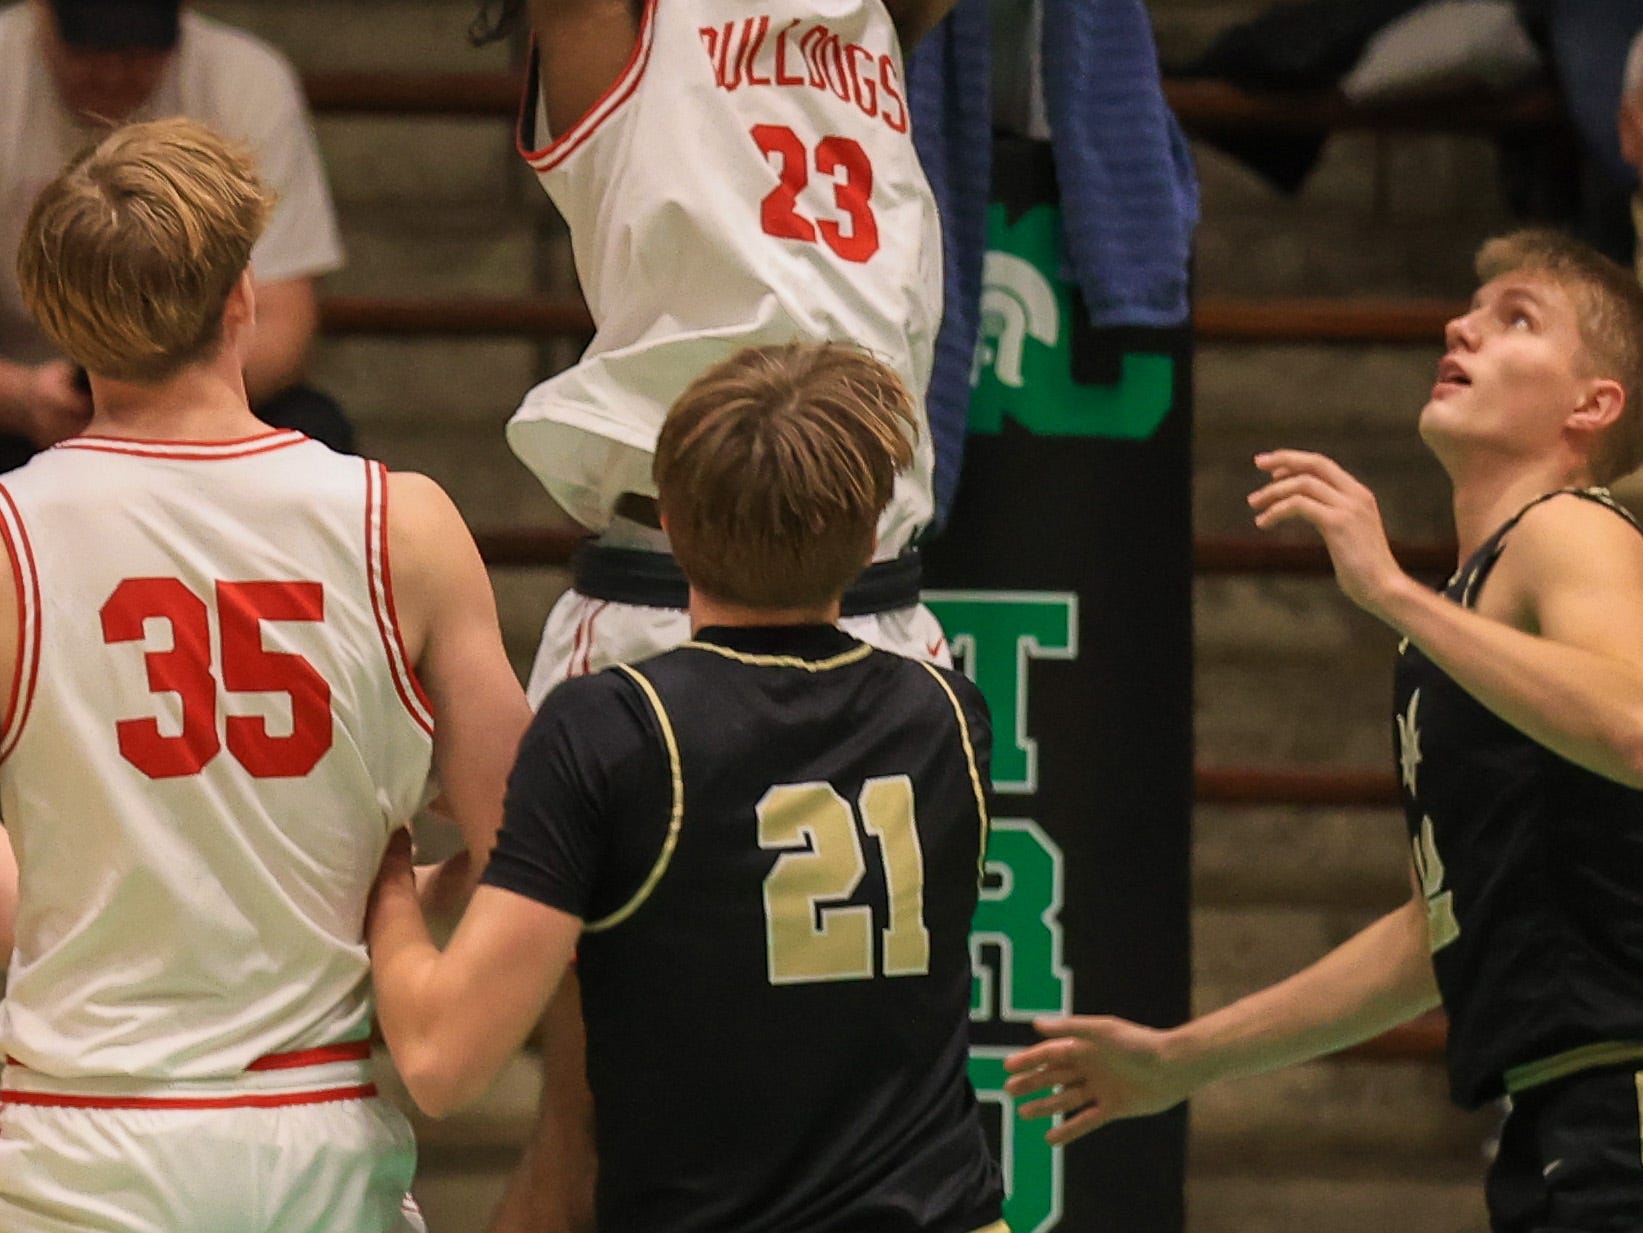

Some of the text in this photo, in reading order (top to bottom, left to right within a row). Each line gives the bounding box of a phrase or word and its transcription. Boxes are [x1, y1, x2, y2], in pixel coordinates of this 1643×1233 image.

[750, 123, 880, 264] 23
[99, 577, 333, 780] 35
[755, 774, 929, 986] 21
